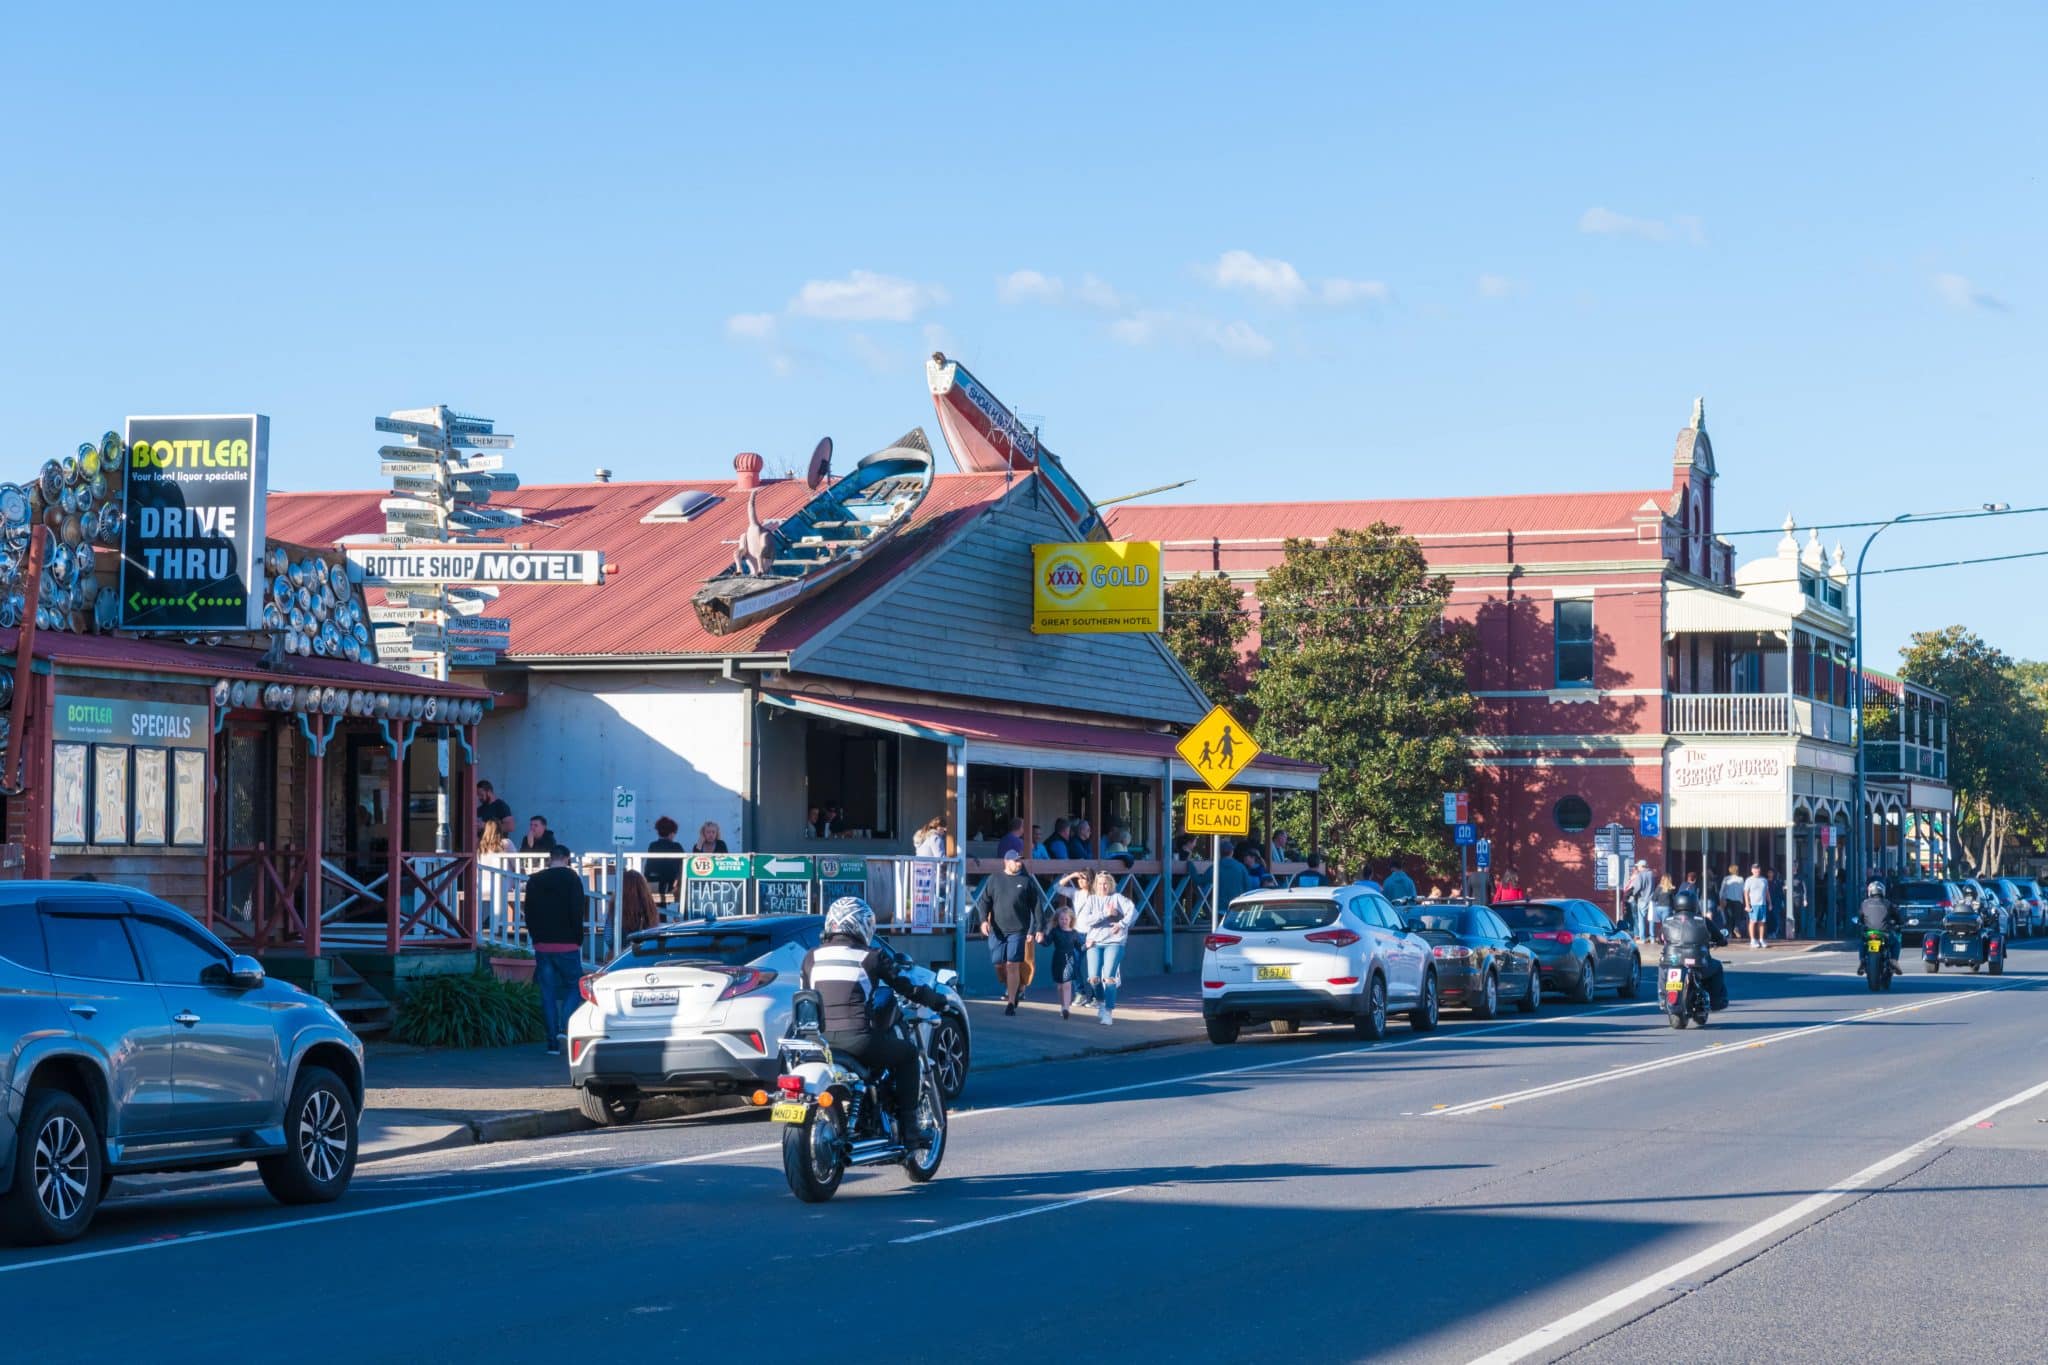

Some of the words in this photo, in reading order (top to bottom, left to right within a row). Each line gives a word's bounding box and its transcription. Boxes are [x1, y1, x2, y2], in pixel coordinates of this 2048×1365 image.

[132, 439, 248, 468] BOTTLER
[391, 464, 416, 472] MUNICH
[132, 471, 151, 481] Your
[154, 471, 175, 481] local
[177, 471, 203, 483] liquor
[205, 470, 248, 483] specialist
[140, 506, 236, 539] DRIVE
[390, 536, 413, 544] LONDON
[143, 548, 228, 580] THRU
[365, 556, 424, 577] BOTTLE
[430, 556, 474, 578] SHOP
[484, 555, 582, 580] MOTEL
[1047, 571, 1084, 585] XXXX
[1091, 565, 1149, 588] GOLD
[1041, 618, 1069, 626] GREAT
[1072, 618, 1120, 626] SOUTHERN
[1123, 617, 1152, 625] HOTEL
[382, 646, 409, 654] LONDON
[68, 705, 112, 724] BOTTLER
[131, 713, 191, 738] SPECIALS
[1675, 763, 1724, 787] BERRY
[1728, 758, 1779, 778] STORES
[617, 793, 634, 808] 2P
[1192, 797, 1243, 812] REFUGE
[1192, 813, 1241, 827] ISLAND
[1644, 806, 1657, 821] P
[694, 861, 711, 870] VB
[823, 862, 837, 871] VB
[691, 881, 743, 902] HAPPY
[691, 901, 736, 917] HOUR
[771, 896, 808, 912] RAFFLE
